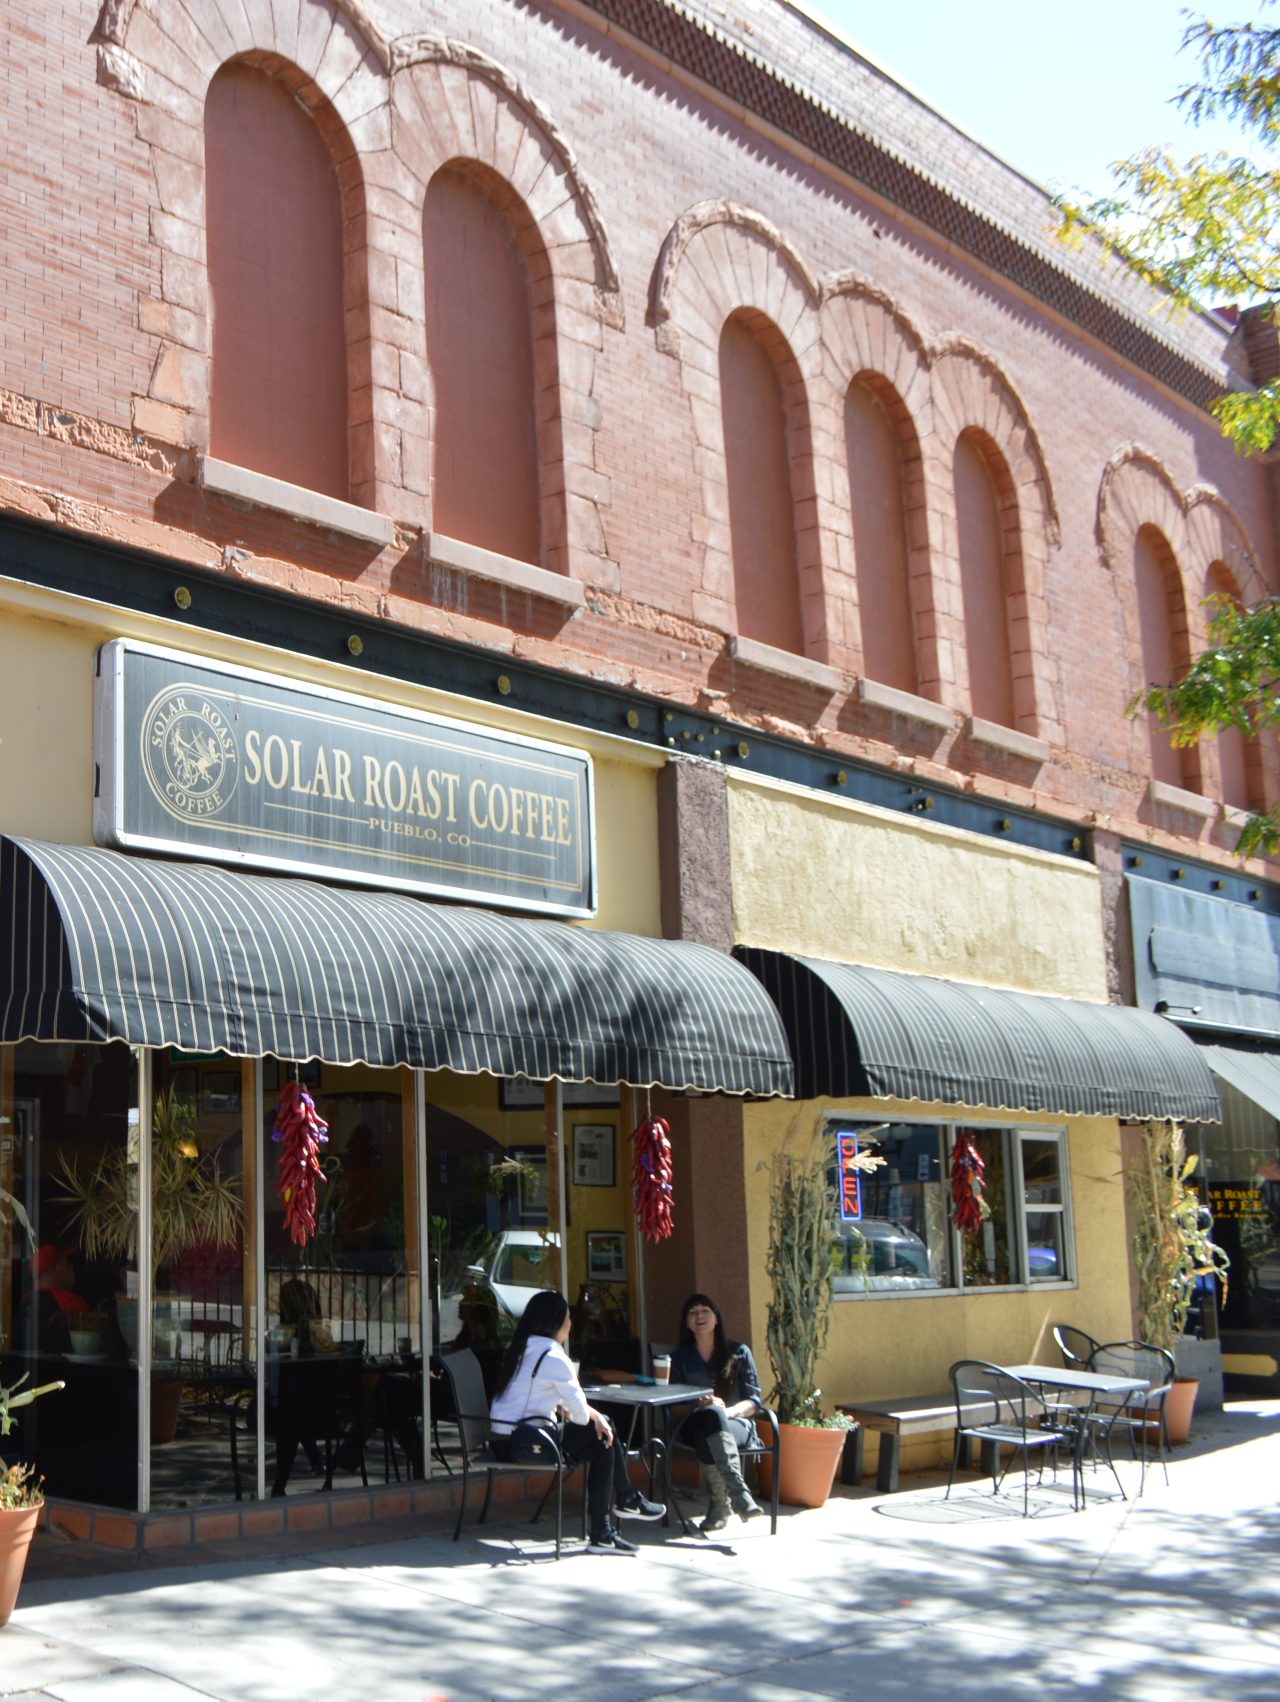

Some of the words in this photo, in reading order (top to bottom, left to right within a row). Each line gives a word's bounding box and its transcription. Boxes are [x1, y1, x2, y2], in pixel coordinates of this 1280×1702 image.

[151, 696, 188, 749] SOLAR
[202, 701, 236, 763] ROAST
[165, 781, 224, 815] COFFEE
[244, 729, 355, 803] SOLAR
[364, 754, 460, 824] ROAST
[469, 779, 573, 846] COFFEE
[368, 817, 444, 843] PUEBLO,
[446, 832, 470, 846] CO
[1207, 1200, 1263, 1212] FFEE
